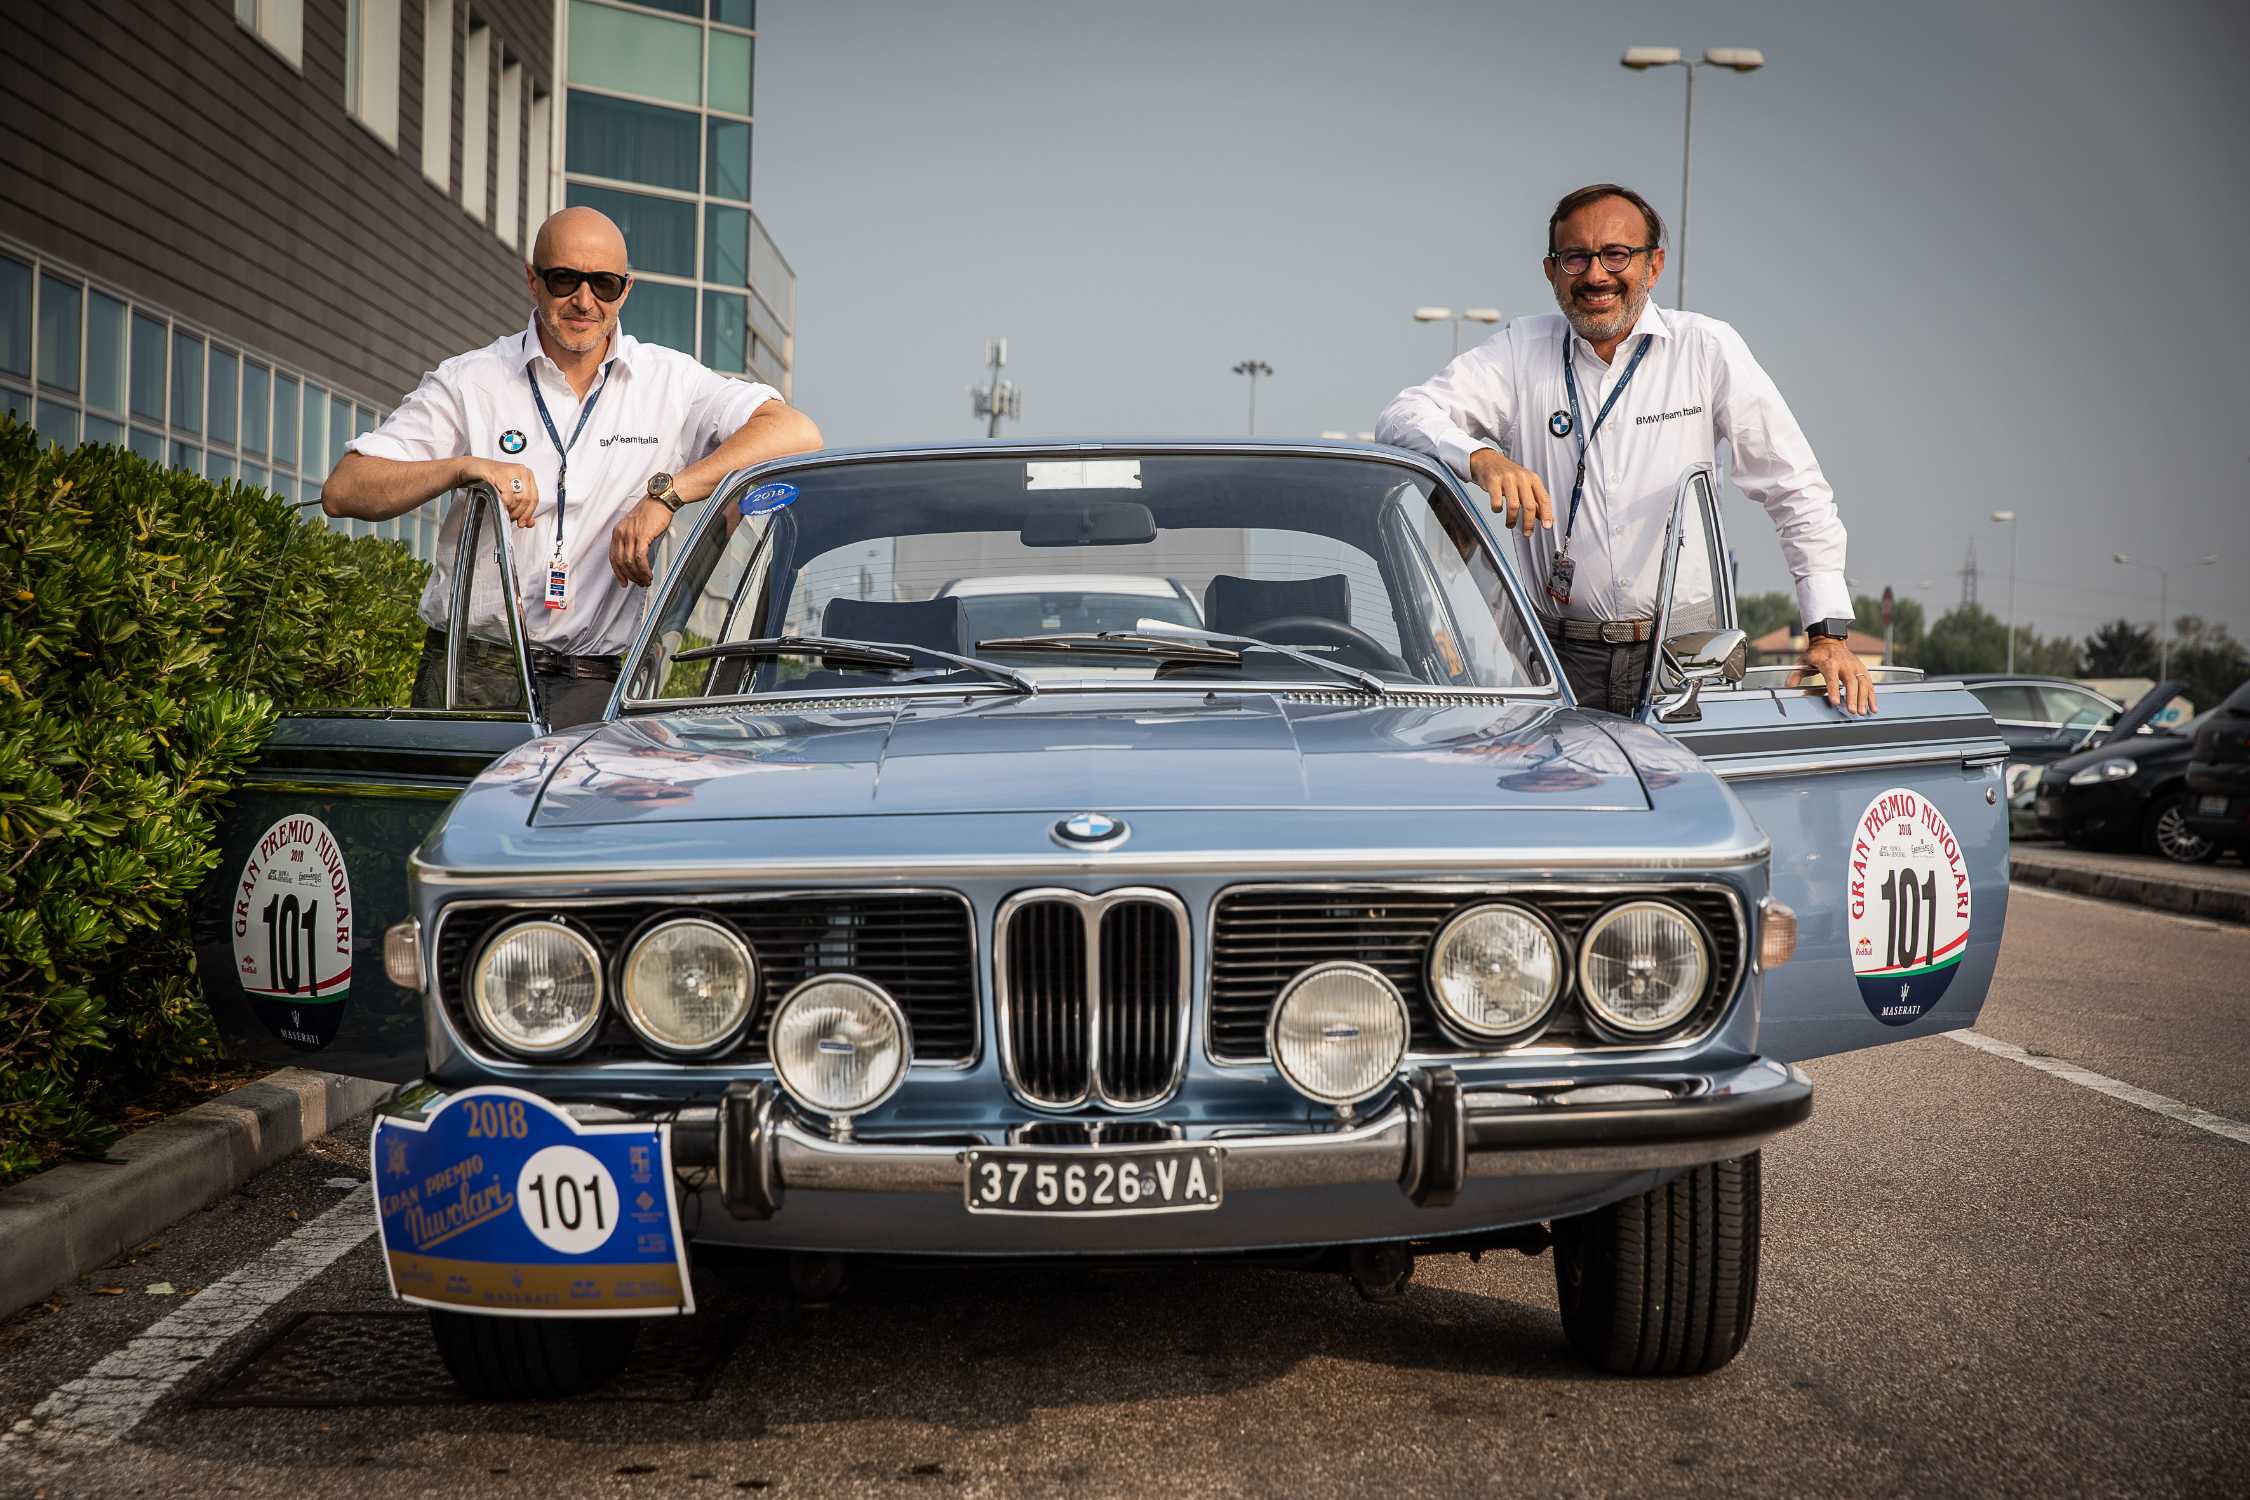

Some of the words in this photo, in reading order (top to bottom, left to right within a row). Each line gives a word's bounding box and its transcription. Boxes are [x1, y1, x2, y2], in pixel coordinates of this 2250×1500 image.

[619, 435, 637, 444] eam
[1636, 415, 1660, 425] BMW
[1661, 410, 1682, 421] Team
[752, 488, 785, 503] 2018
[1852, 837, 1871, 920] GRAN
[1864, 794, 1916, 840] PREMIO
[1921, 803, 1969, 919] NUVOLARI
[235, 857, 261, 938] GRAN
[260, 820, 314, 863] PREMIO
[315, 831, 350, 955] NUVOLARI
[1881, 867, 1937, 969] 101
[262, 893, 318, 997] 101
[1881, 1004, 1921, 1016] MASERATI
[280, 1028, 320, 1045] MASERATI
[463, 1100, 529, 1139] 2018
[425, 1154, 484, 1198] PREMIO
[980, 1162, 1141, 1205] 375626
[1155, 1157, 1208, 1201] VA
[403, 1173, 503, 1246] Nuvolari
[528, 1173, 606, 1231] 101
